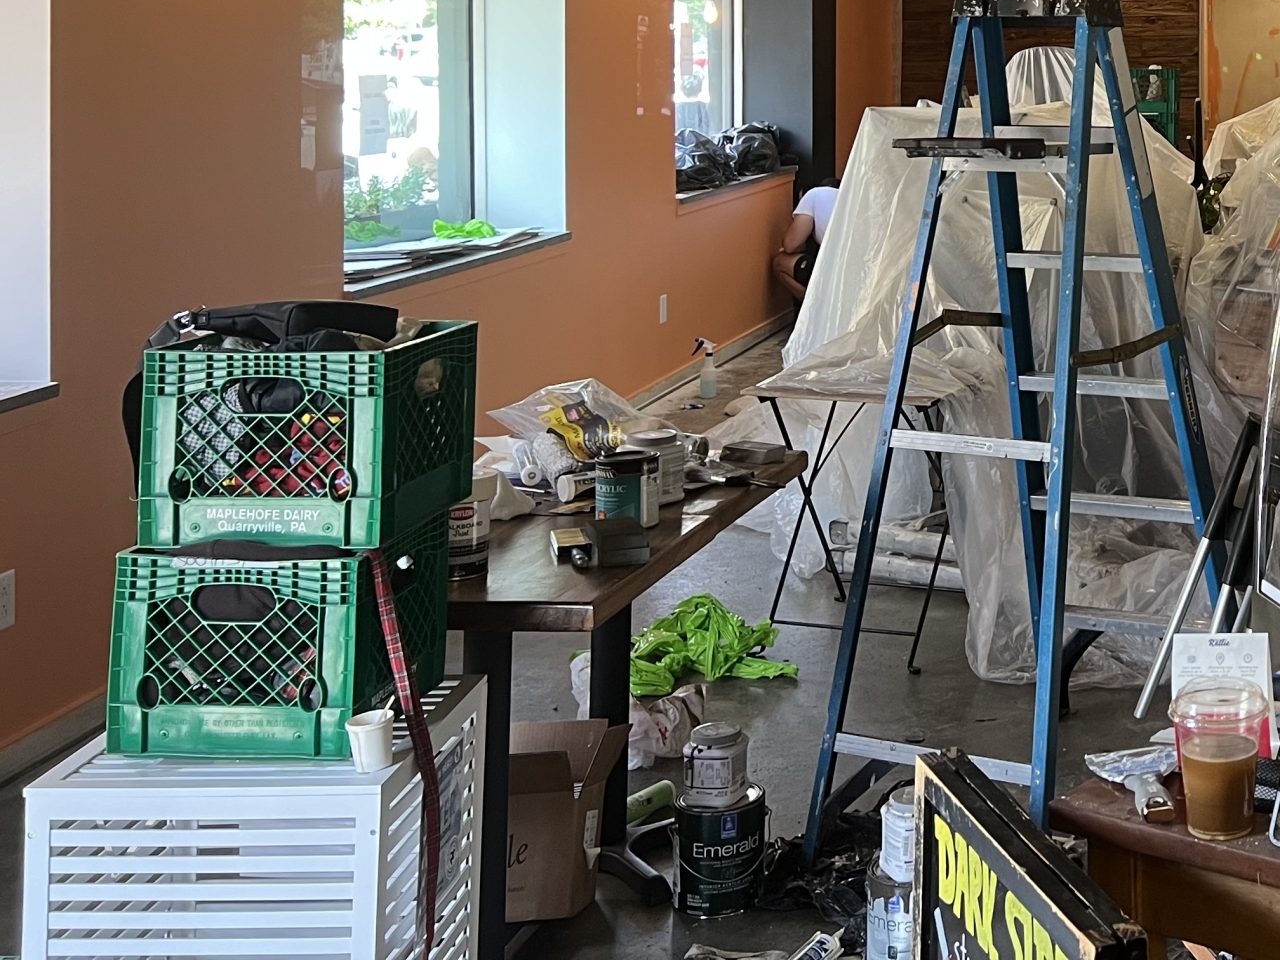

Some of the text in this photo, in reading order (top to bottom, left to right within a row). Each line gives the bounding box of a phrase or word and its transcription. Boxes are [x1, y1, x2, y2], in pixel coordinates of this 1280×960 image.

[206, 508, 321, 521] MAPLEHOFE DAIRY
[217, 520, 307, 534] Quarryville, PA
[692, 830, 760, 859] Emerald
